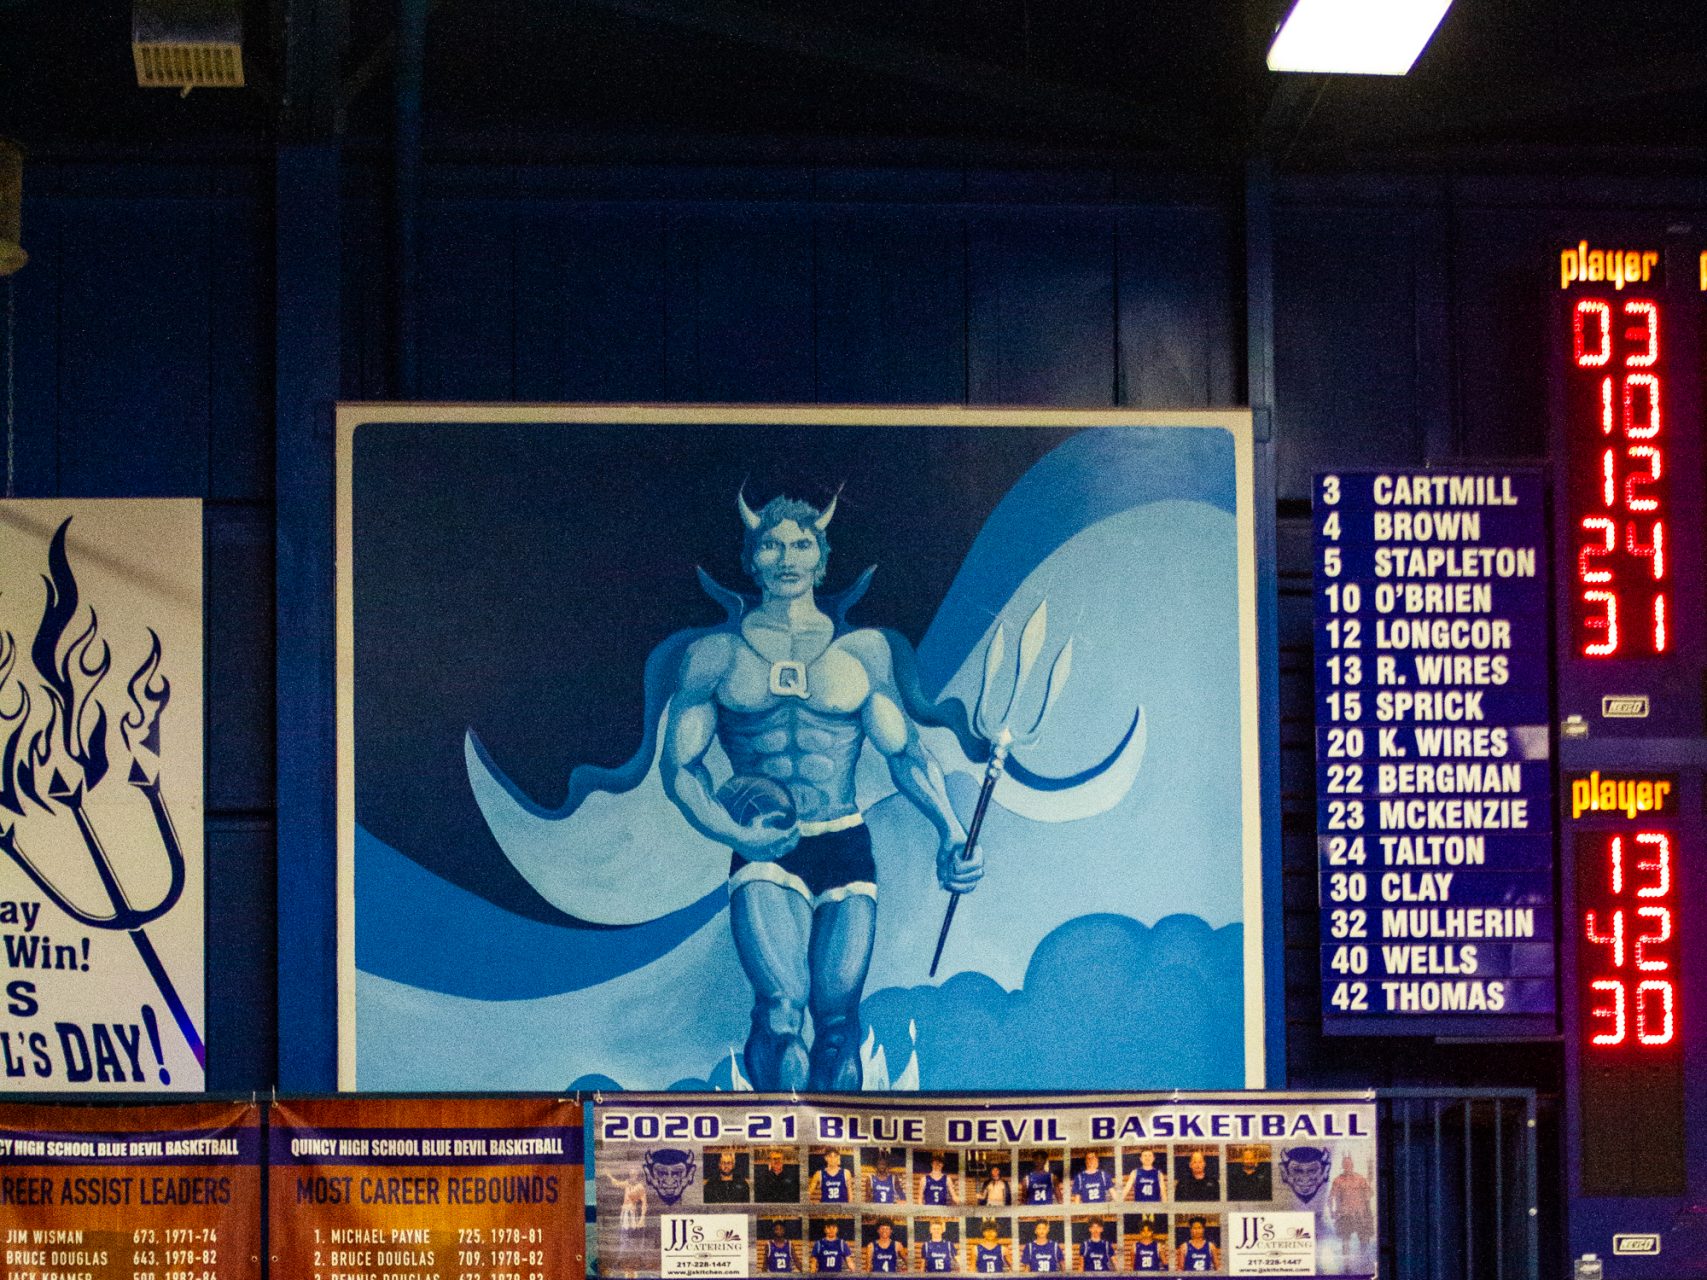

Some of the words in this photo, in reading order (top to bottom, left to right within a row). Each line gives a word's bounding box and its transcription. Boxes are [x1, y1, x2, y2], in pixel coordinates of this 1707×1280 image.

[1561, 240, 1659, 290] player
[1574, 301, 1658, 366] 03
[1602, 373, 1660, 439] 10
[1322, 475, 1341, 505] 3
[1373, 475, 1519, 506] CARTMILL
[1604, 445, 1661, 511] 12
[1322, 512, 1341, 541] 4
[1374, 511, 1480, 541] BROWN
[1323, 548, 1341, 577] 5
[1374, 547, 1536, 578] STAPLETON
[1579, 518, 1664, 583] 24
[1325, 583, 1361, 613] 10
[1375, 583, 1492, 613] O'BRIEN
[1326, 620, 1362, 649] 12
[1375, 619, 1511, 649] LONGCOR
[1583, 589, 1665, 657] 31
[1326, 656, 1362, 685] 13
[1376, 656, 1406, 685] R.
[1415, 656, 1509, 685] WIRES
[1326, 692, 1362, 721] 15
[1376, 692, 1484, 721] SPRICK
[1327, 729, 1364, 757] 20
[1378, 729, 1406, 757] K.
[1415, 728, 1509, 757] WIRES
[1327, 765, 1364, 794] 22
[1378, 764, 1521, 793] BERGMAN
[1571, 770, 1671, 819] player
[1327, 801, 1365, 830] 23
[1380, 800, 1528, 829] MCKENZIE
[1329, 837, 1366, 866] 24
[1380, 837, 1485, 865] TALTON
[1612, 833, 1670, 898] 13
[1330, 873, 1367, 902] 30
[1381, 873, 1454, 902] CLAY
[1330, 909, 1367, 938] 32
[1381, 909, 1534, 938] MULHERIN
[1585, 906, 1672, 971] 42
[3, 934, 90, 972] Win!
[1331, 945, 1368, 975] 40
[1382, 945, 1478, 974] WELLS
[1331, 981, 1368, 1011] 42
[1382, 981, 1505, 1011] THOMAS
[1591, 979, 1674, 1045] 30
[54, 1004, 171, 1086] DAY!
[603, 1113, 799, 1143] 2020-21
[816, 1113, 927, 1144] BLUE
[946, 1116, 1068, 1144] DEVIL
[1090, 1112, 1370, 1142] BASKETBALL
[14, 1139, 45, 1156] HIGH
[47, 1141, 96, 1157] SCHOOL
[97, 1142, 128, 1157] BLUE
[129, 1140, 164, 1157] DEVIL
[165, 1138, 239, 1156] BASKETBALL
[291, 1138, 337, 1156] QUINCY
[339, 1138, 370, 1156] HIGH
[371, 1138, 420, 1156] SCHOOL
[421, 1139, 452, 1157] BLUE
[453, 1139, 489, 1156] DEVIL
[489, 1138, 564, 1156] BASKETBALL
[61, 1177, 133, 1205] ASSIST
[140, 1177, 231, 1205] LEADERS
[296, 1176, 353, 1206] MOST
[360, 1176, 440, 1206] CAREER
[448, 1176, 559, 1205] REBOUNDS
[6, 1229, 28, 1244] JIM
[33, 1229, 83, 1244] WISMAN
[165, 1228, 217, 1244] 1971-74
[314, 1229, 325, 1244] 1.
[331, 1229, 386, 1244] MICHAEL
[391, 1229, 430, 1244] PAYNE
[491, 1228, 543, 1243] 1978-81
[686, 1243, 742, 1251] CATERING
[1257, 1241, 1312, 1249] CATERING
[6, 1250, 46, 1266] BRUCE
[51, 1250, 108, 1266] DOUGLAS
[165, 1250, 217, 1265] 1978-82
[314, 1251, 325, 1266] 2.
[331, 1251, 372, 1266] BRUCE
[377, 1251, 435, 1266] DOUGLAS
[491, 1250, 543, 1266] 1978-82
